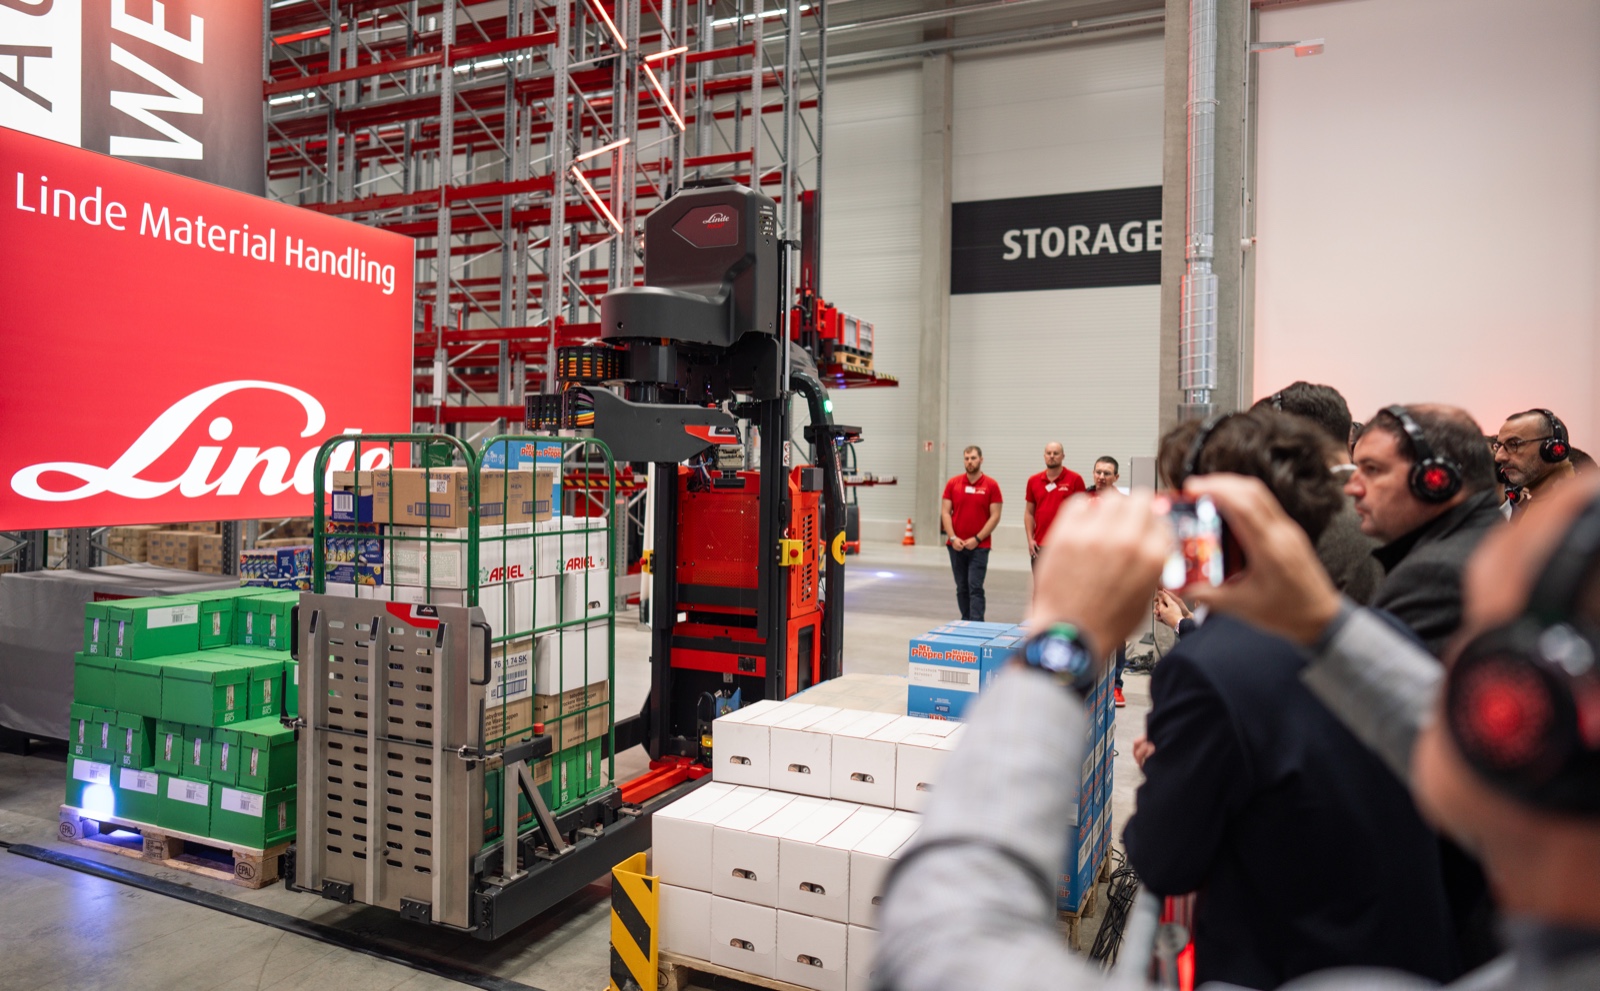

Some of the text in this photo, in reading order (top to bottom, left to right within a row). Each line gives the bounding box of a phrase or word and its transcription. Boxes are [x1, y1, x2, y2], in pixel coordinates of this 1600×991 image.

[702, 212, 730, 224] Linde
[16, 172, 396, 295] Linde Material Handling
[1002, 219, 1162, 260] STORAGE
[10, 379, 392, 502] Linde
[911, 647, 978, 664] Propre Proper
[61, 824, 73, 835] EPAL
[238, 865, 252, 877] EPAL
